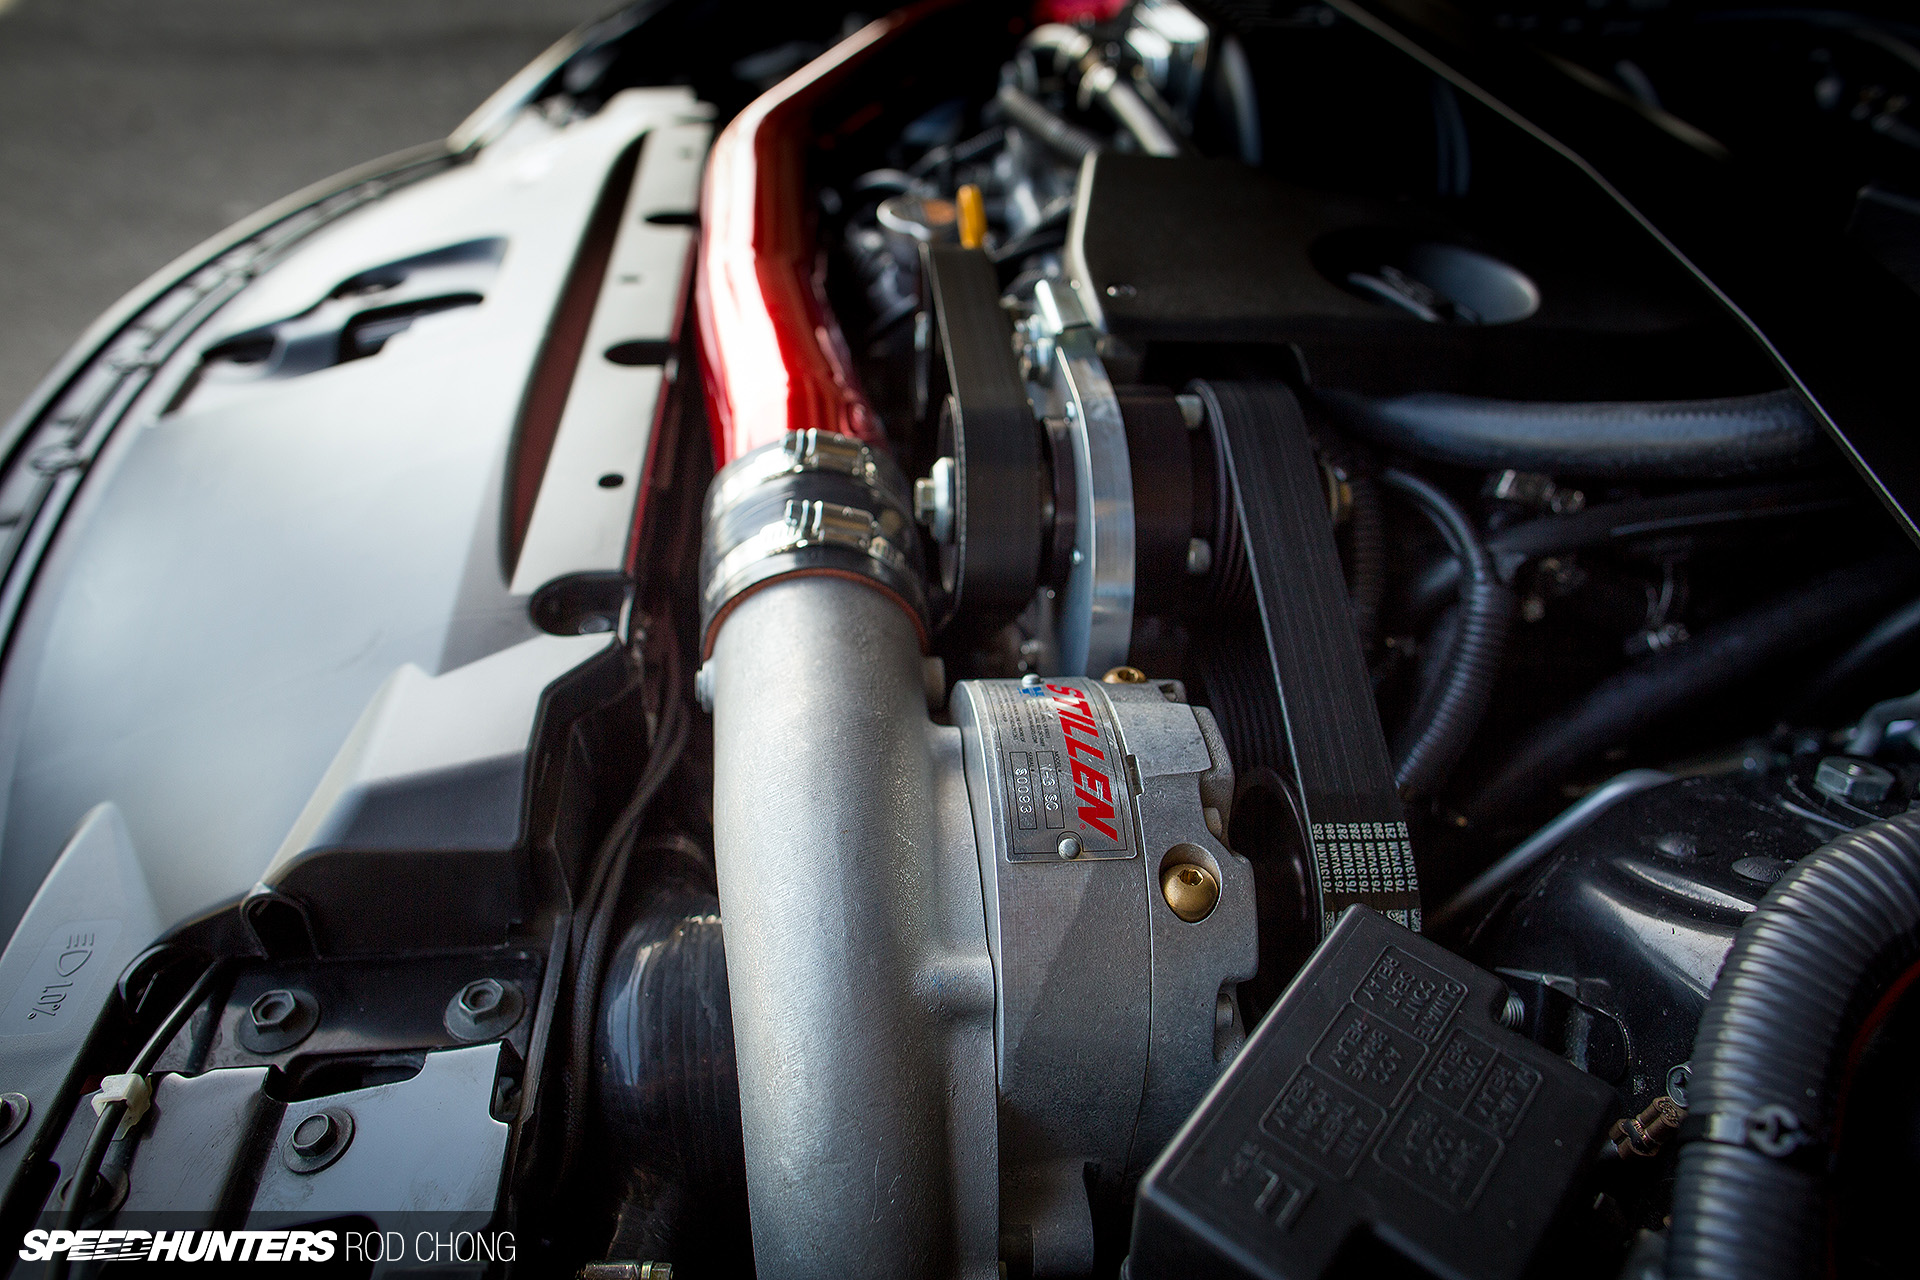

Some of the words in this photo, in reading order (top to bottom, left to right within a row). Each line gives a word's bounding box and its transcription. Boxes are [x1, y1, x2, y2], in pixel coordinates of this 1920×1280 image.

[1045, 684, 1119, 843] STILLEN
[1043, 793, 1059, 811] SC
[1362, 955, 1399, 1001] RELAY
[1385, 970, 1416, 1008] SEAT
[1402, 980, 1436, 1021] CONT
[1414, 982, 1462, 1041] CLIMATE
[1329, 1018, 1369, 1068] RELAY
